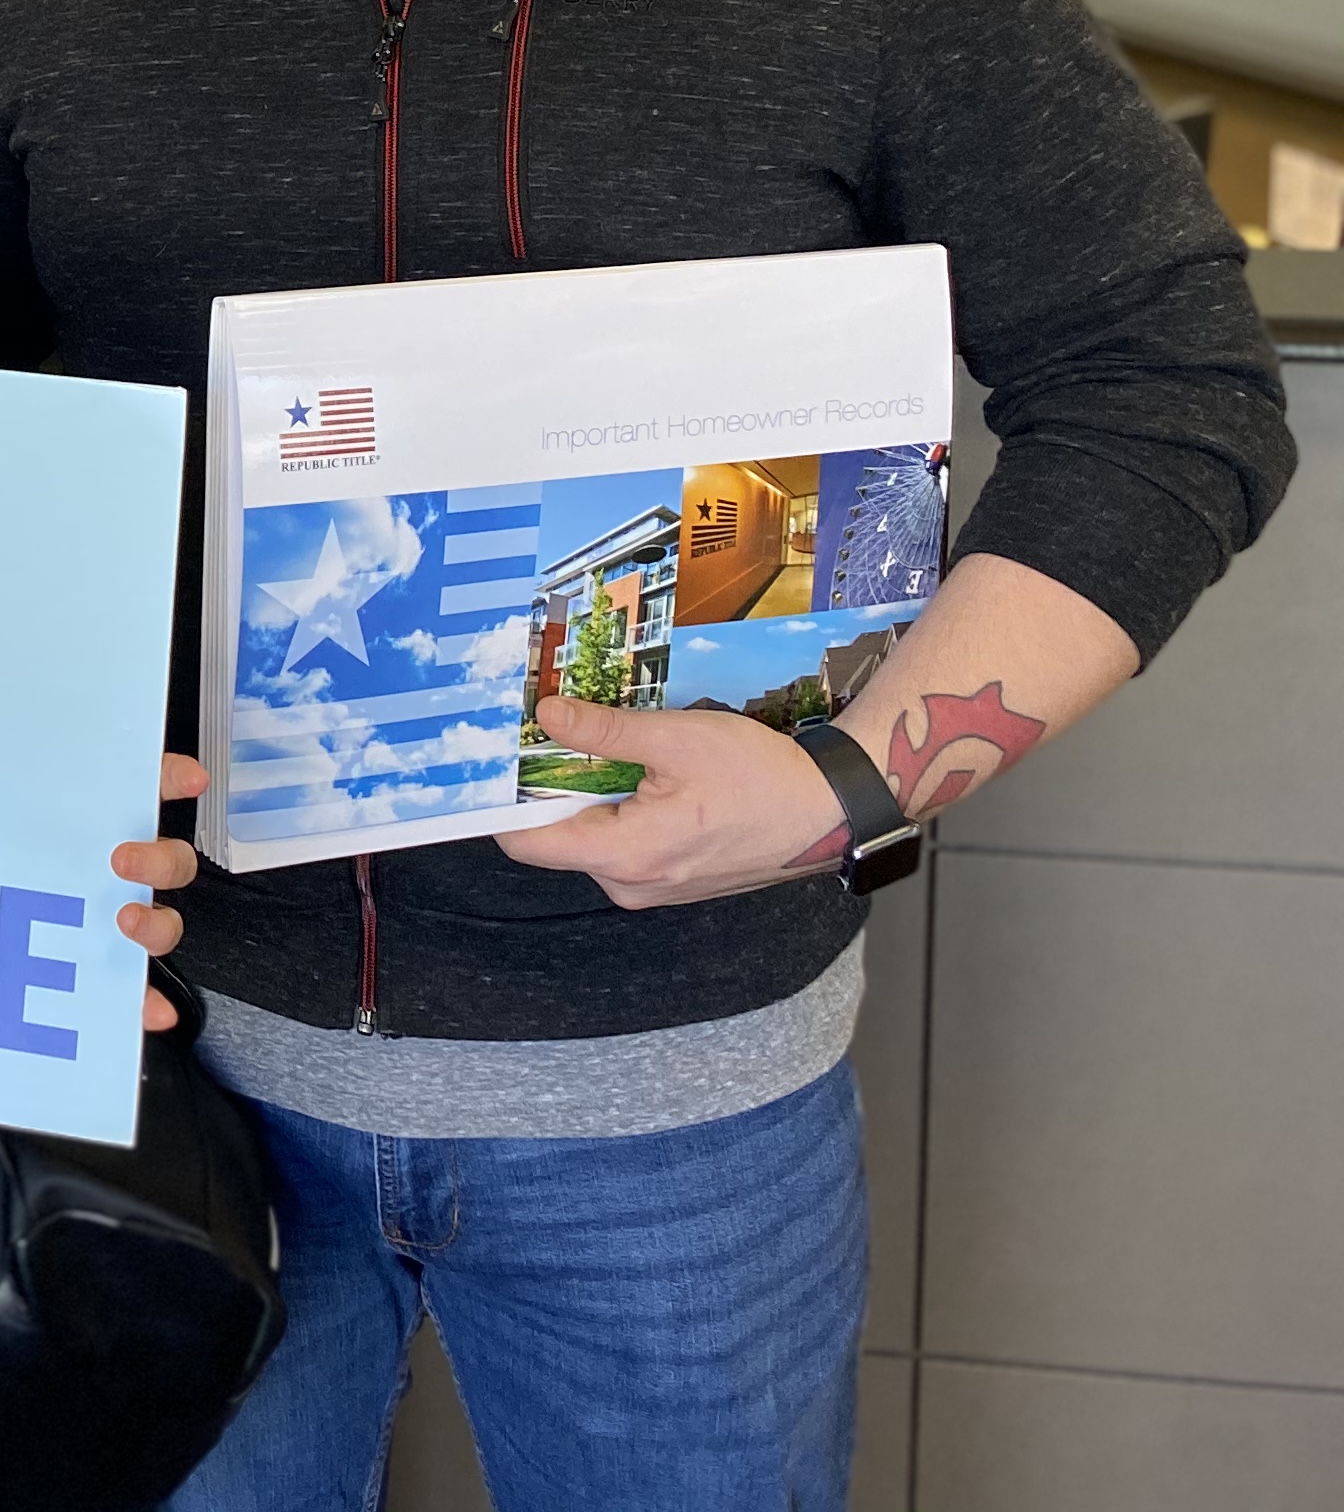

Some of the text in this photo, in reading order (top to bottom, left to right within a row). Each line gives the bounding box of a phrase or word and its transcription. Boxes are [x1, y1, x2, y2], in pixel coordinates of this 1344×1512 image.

[541, 394, 924, 453] Important Homeowner Records
[281, 458, 340, 473] REPUBLIC
